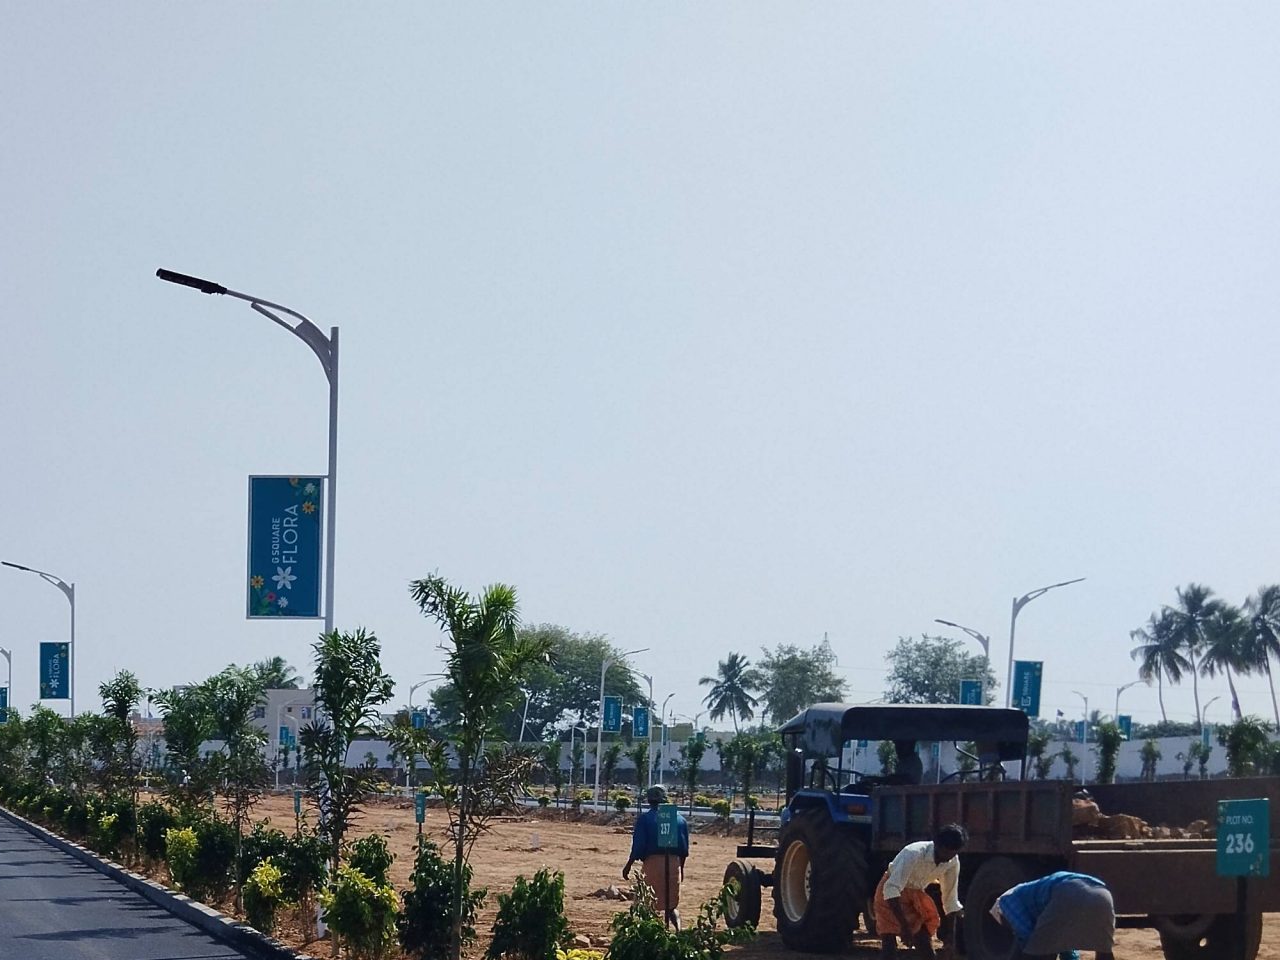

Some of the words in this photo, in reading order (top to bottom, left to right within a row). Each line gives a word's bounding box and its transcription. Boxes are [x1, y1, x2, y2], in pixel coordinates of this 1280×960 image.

[271, 517, 280, 556] SQUARE
[282, 504, 299, 564] FLORA
[1226, 815, 1241, 825] PLOT
[1225, 833, 1254, 854] 236
